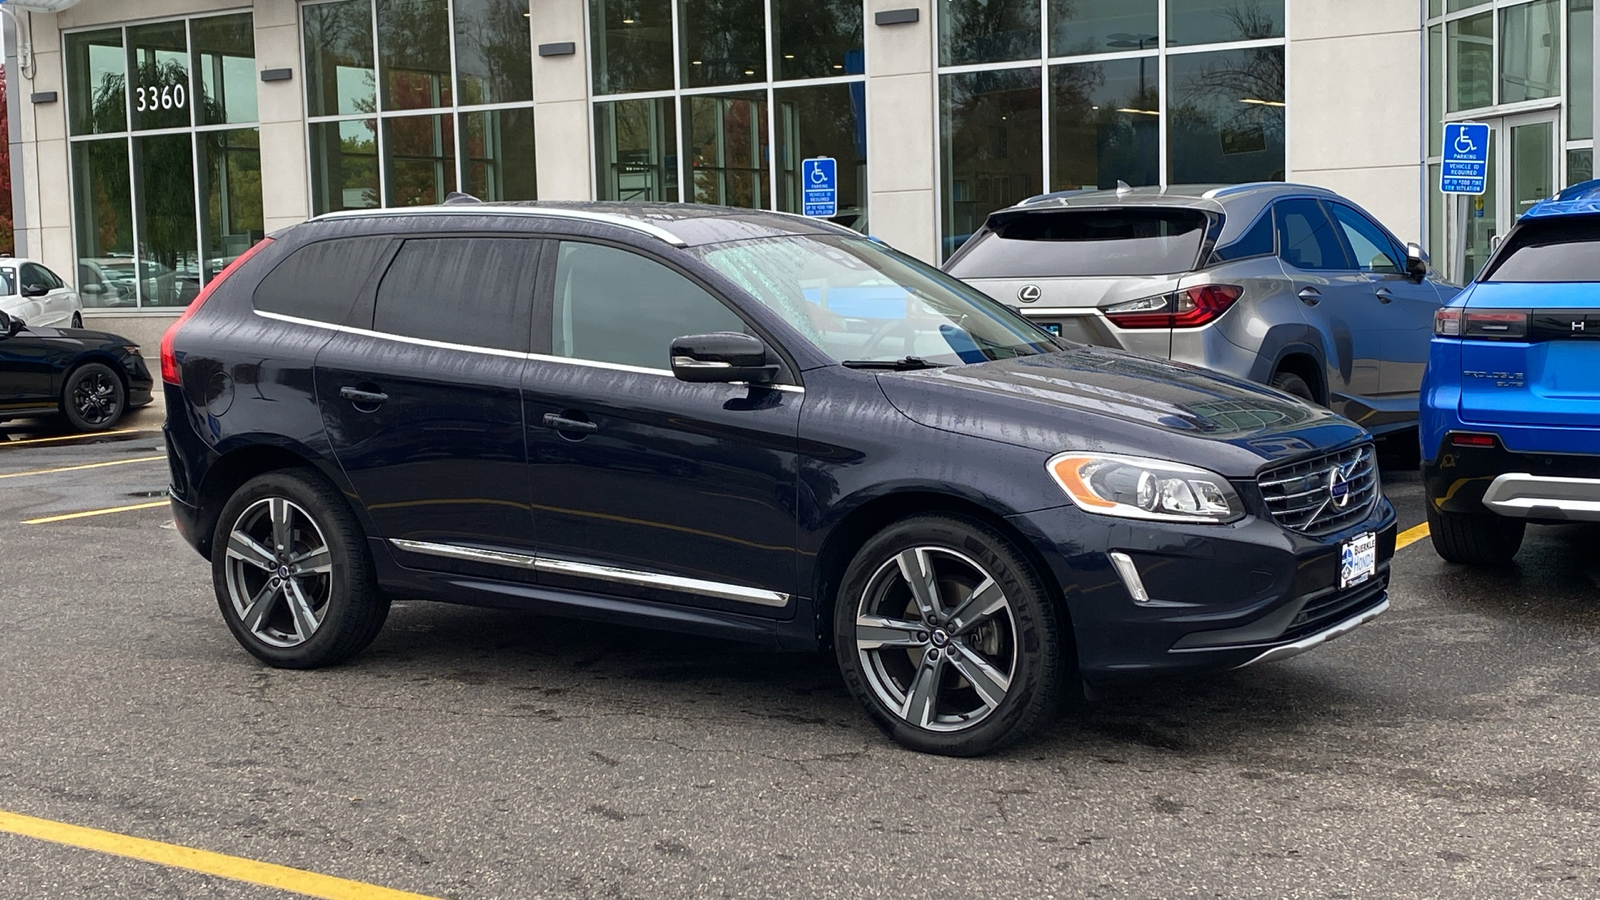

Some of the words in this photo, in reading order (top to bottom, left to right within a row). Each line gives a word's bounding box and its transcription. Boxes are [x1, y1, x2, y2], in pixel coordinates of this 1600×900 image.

[136, 83, 185, 112] 3360
[1354, 539, 1376, 556] BUERKLE
[1353, 551, 1375, 573] HONDA
